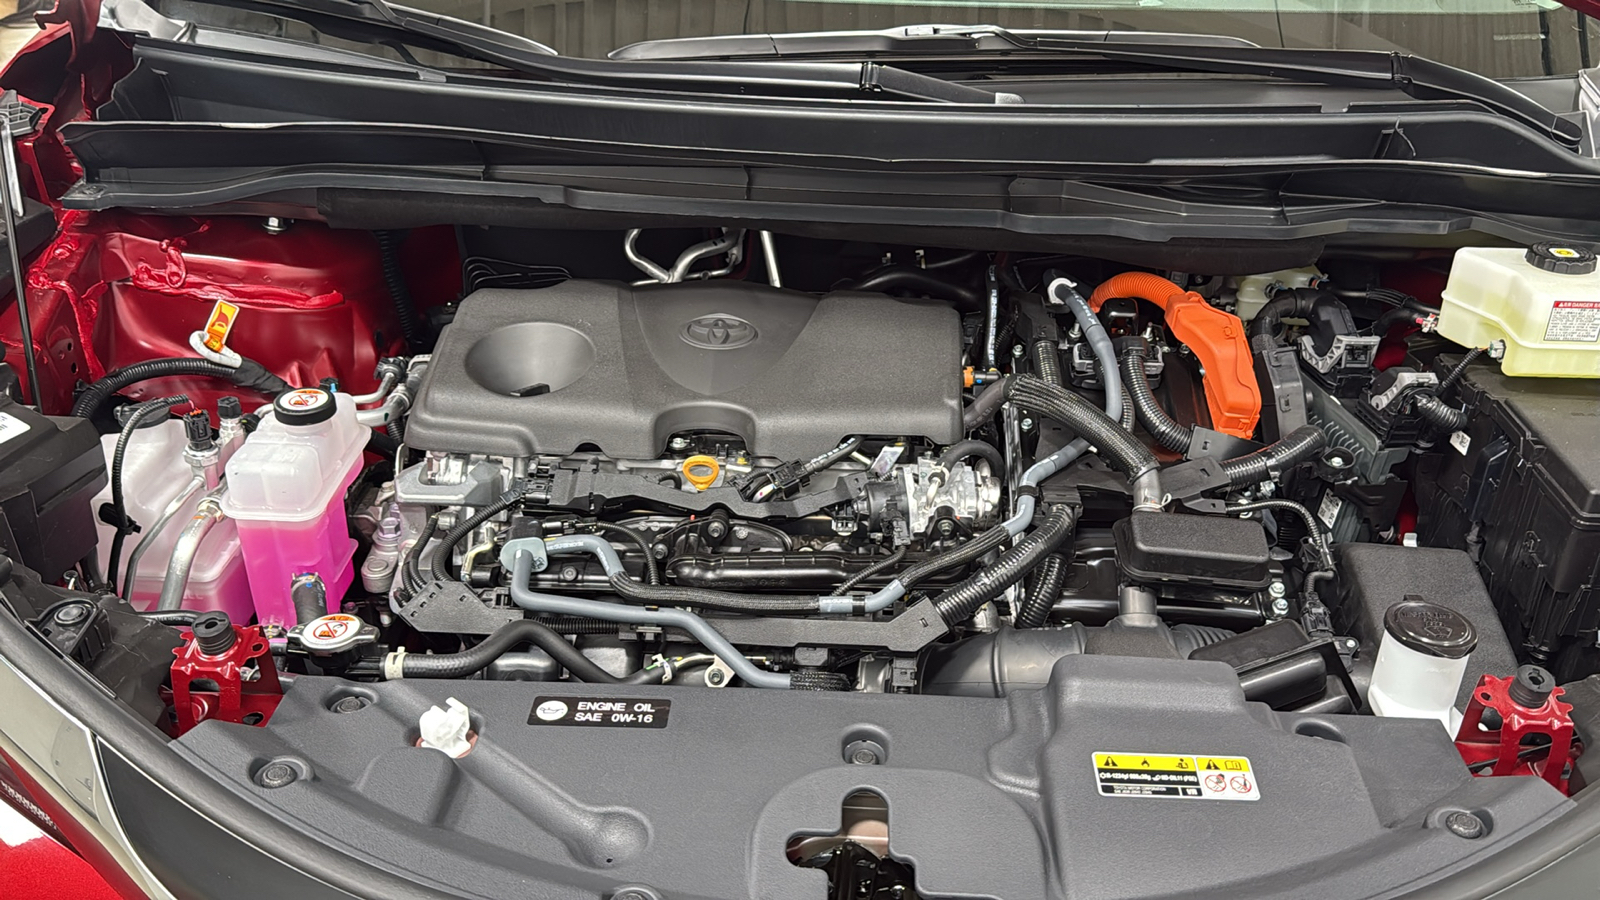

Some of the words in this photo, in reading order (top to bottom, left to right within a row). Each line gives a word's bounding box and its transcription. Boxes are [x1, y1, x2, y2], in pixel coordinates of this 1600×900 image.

[577, 702, 626, 711] ENGINE
[634, 703, 655, 712] OIL
[574, 712, 603, 722] SAE
[611, 713, 653, 723] 0W-16
